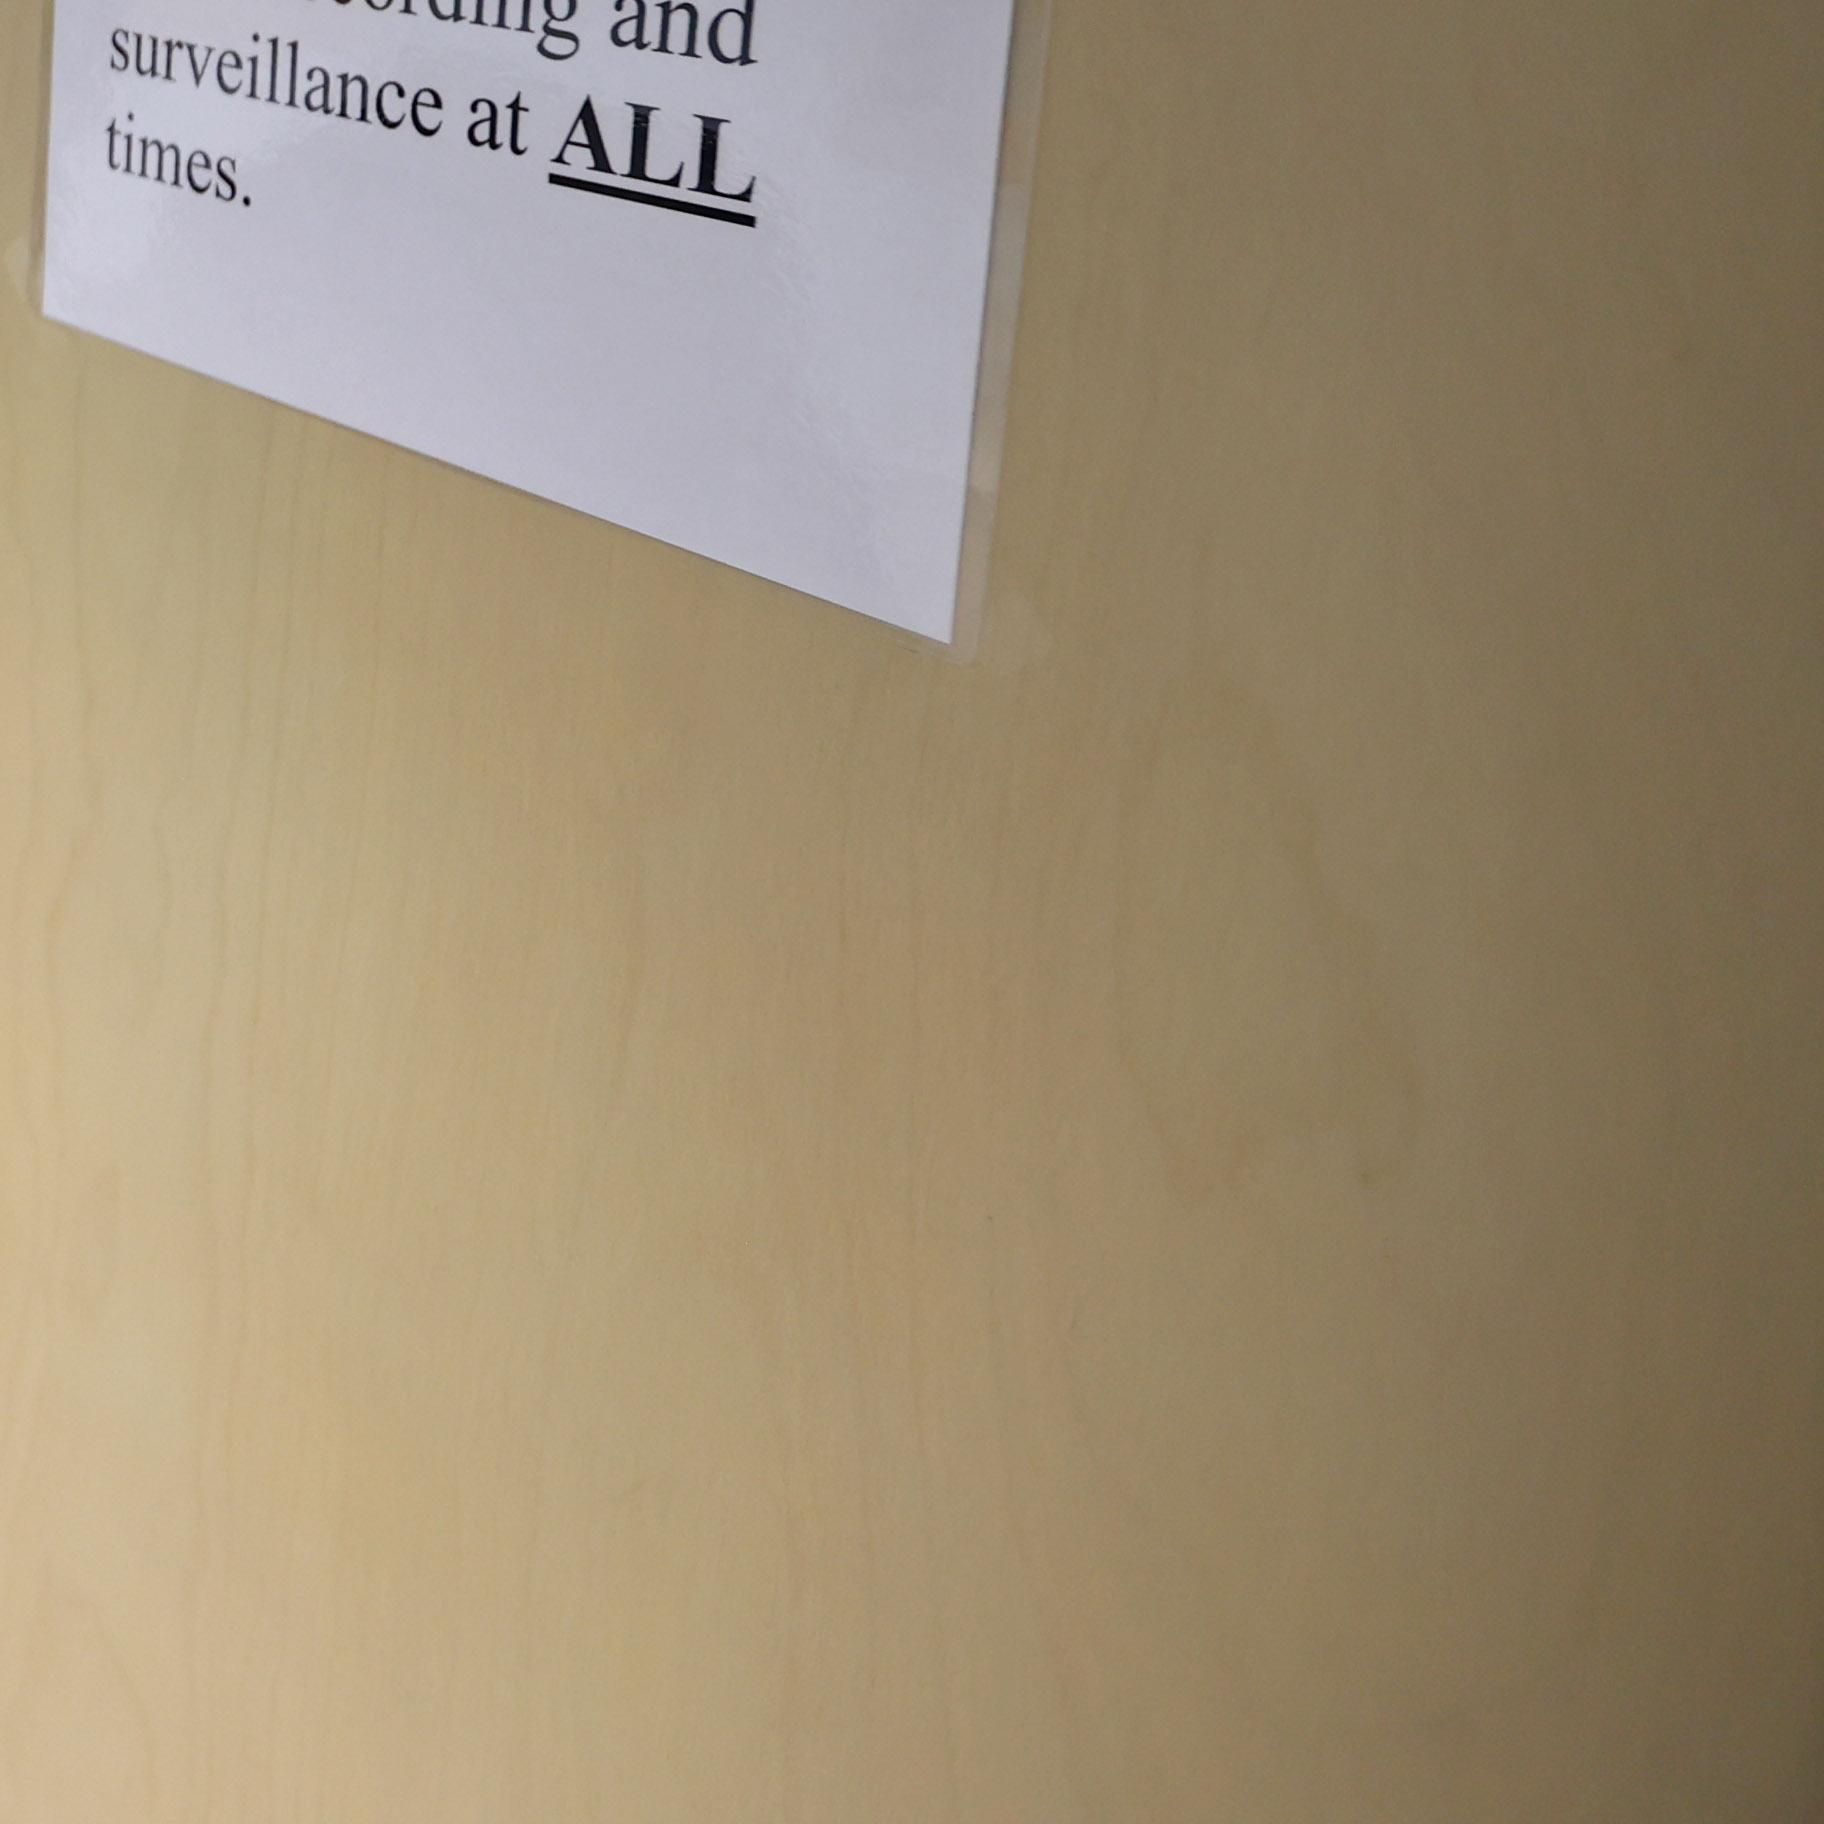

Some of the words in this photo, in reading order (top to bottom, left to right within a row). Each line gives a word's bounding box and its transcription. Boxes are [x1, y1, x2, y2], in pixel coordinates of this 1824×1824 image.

[104, 112, 252, 208] times.
[108, 28, 444, 139] surveillance
[466, 91, 531, 157] at
[550, 95, 757, 204] ALL
